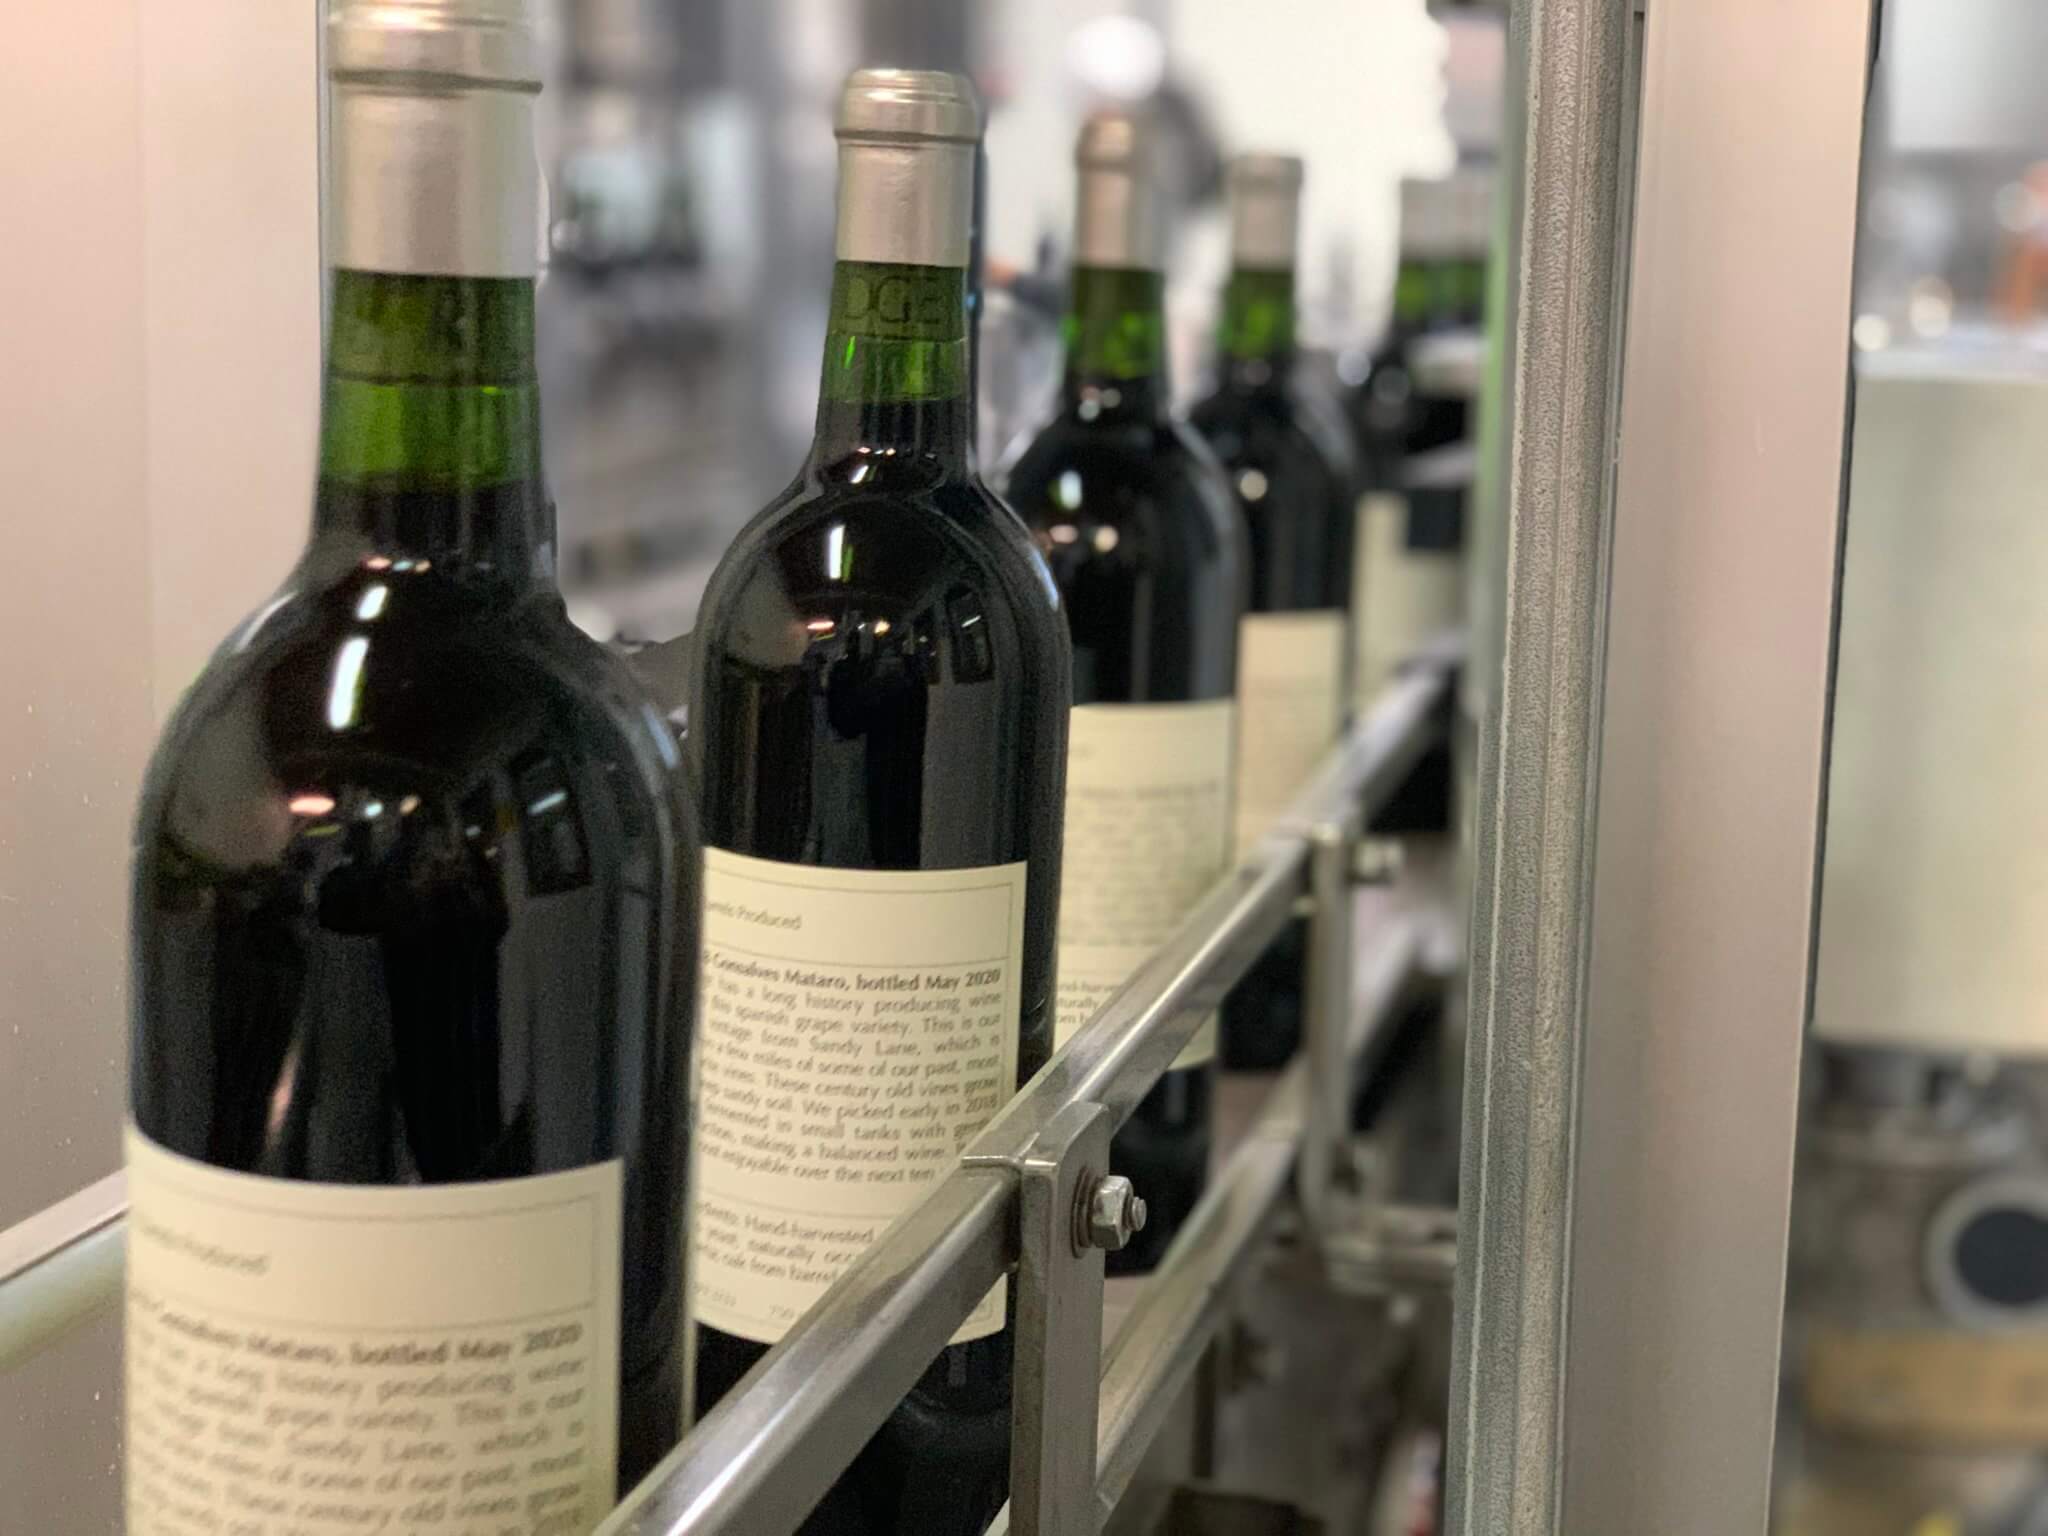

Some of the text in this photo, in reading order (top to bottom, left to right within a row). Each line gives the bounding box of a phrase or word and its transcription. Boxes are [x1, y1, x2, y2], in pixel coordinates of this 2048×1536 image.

[856, 973, 920, 992] bottled
[925, 974, 961, 992] May
[965, 967, 1001, 987] 2020
[873, 995, 961, 1017] producing
[922, 1016, 955, 1033] This
[810, 1035, 862, 1058] Sandy
[875, 1039, 921, 1057] Lane,
[934, 1034, 981, 1054] which
[814, 1083, 880, 1101] century
[886, 1081, 914, 1098] old
